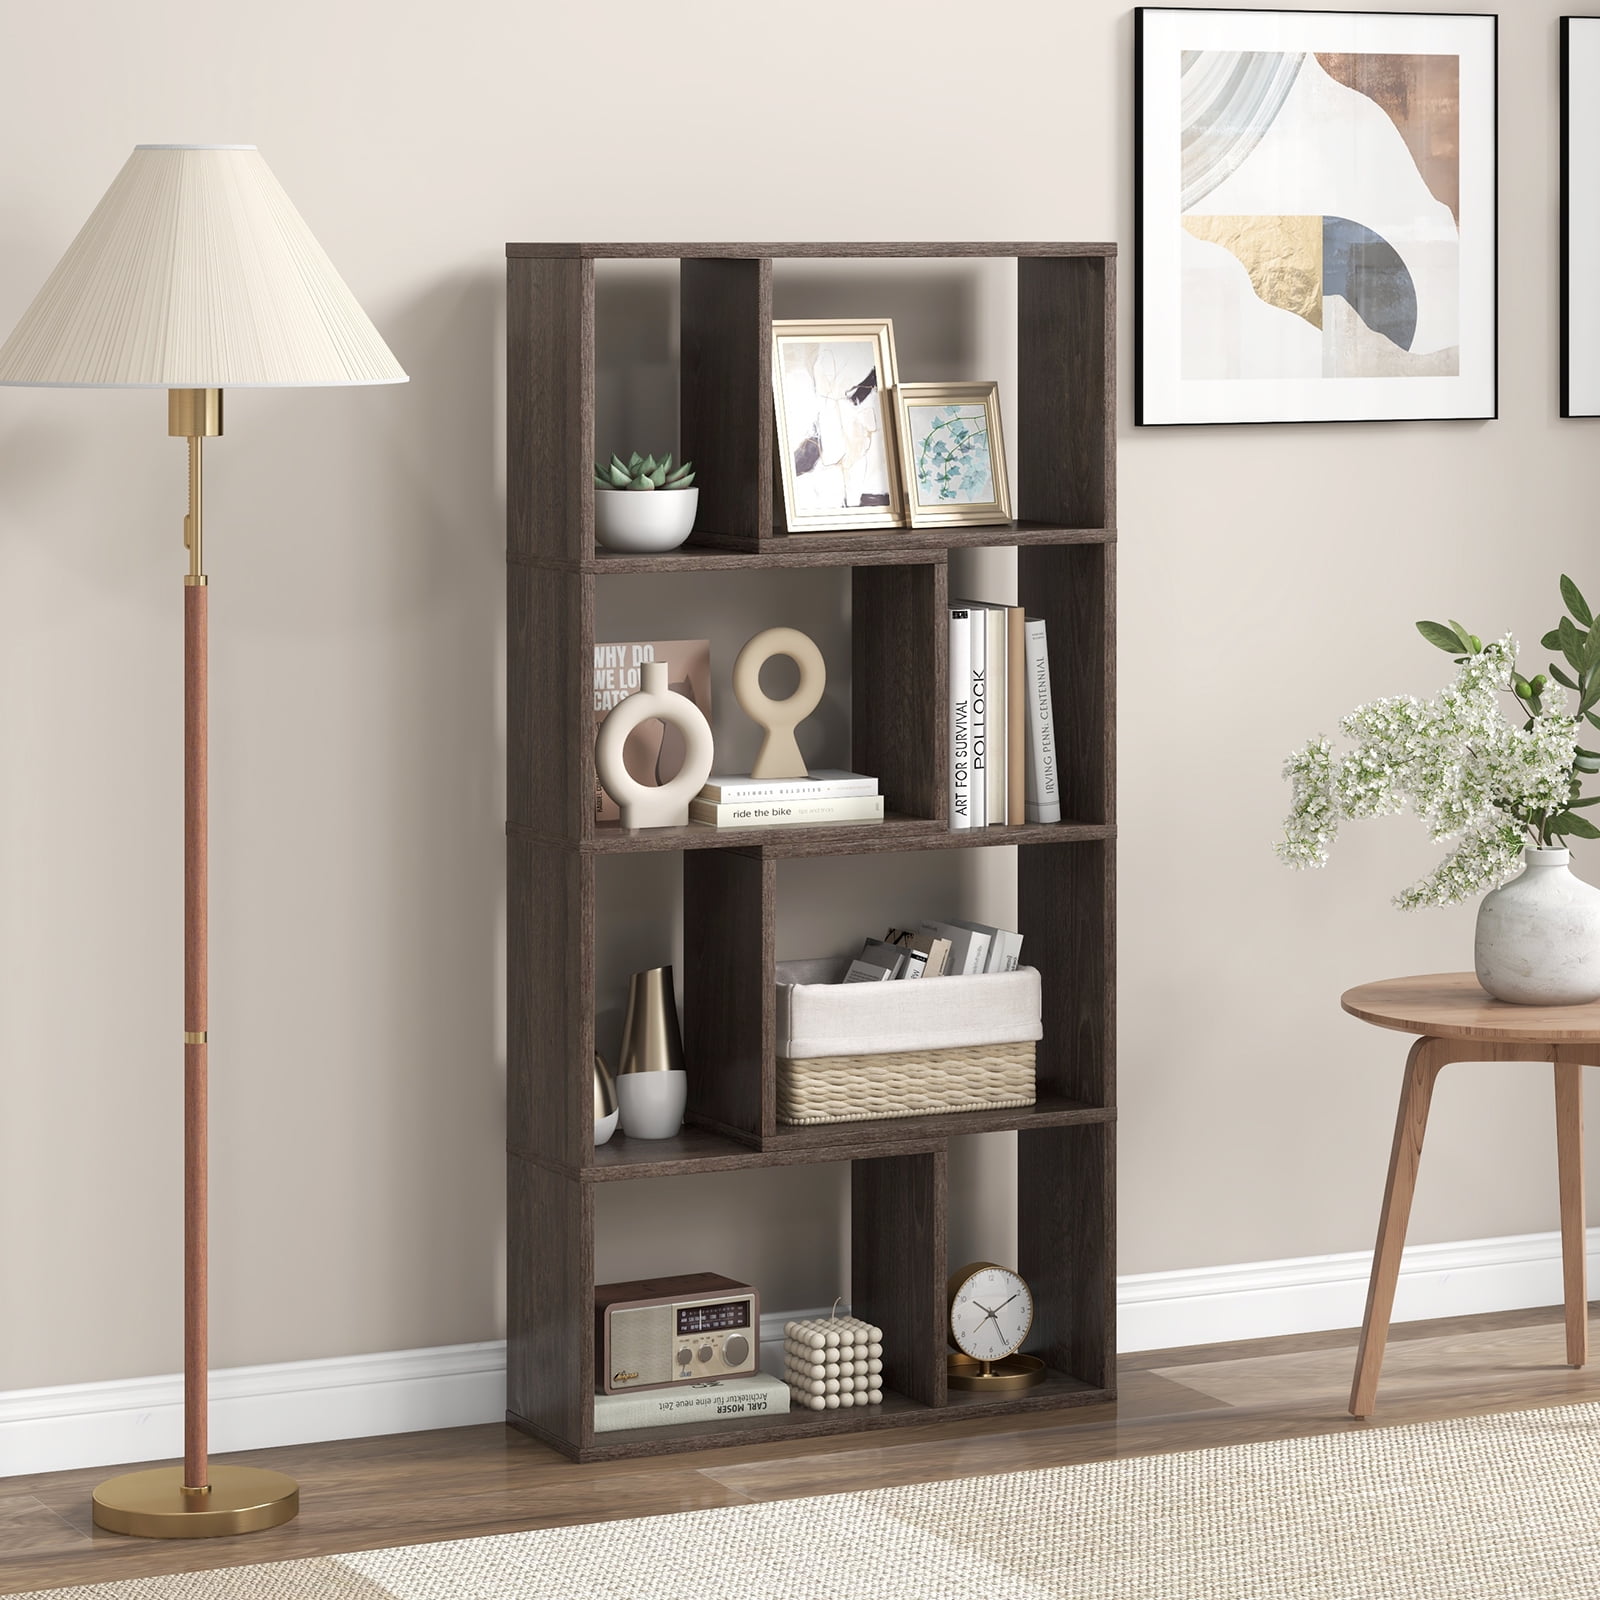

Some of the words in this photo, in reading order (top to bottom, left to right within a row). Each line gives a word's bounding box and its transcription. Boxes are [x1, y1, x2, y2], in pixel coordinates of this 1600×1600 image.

[594, 645, 627, 668] WHY
[632, 644, 654, 667] DO
[594, 668, 615, 689] WE
[1036, 656, 1049, 720] CENTENNIAL
[973, 670, 985, 769] POLLOCK
[955, 700, 968, 757] SURVIVAL
[955, 762, 968, 788] FOR
[1043, 755, 1055, 794] IRVING
[955, 792, 968, 816] ART
[733, 809, 751, 818] ride
[754, 808, 770, 817] the
[772, 807, 792, 816] bike
[659, 1401, 674, 1411] Zeit
[676, 1399, 694, 1407] neue
[696, 1397, 712, 1405] eine
[713, 1396, 725, 1405] für
[726, 1393, 768, 1403] Architektur
[748, 1401, 767, 1411] CARL
[717, 1404, 744, 1414] MOSER
